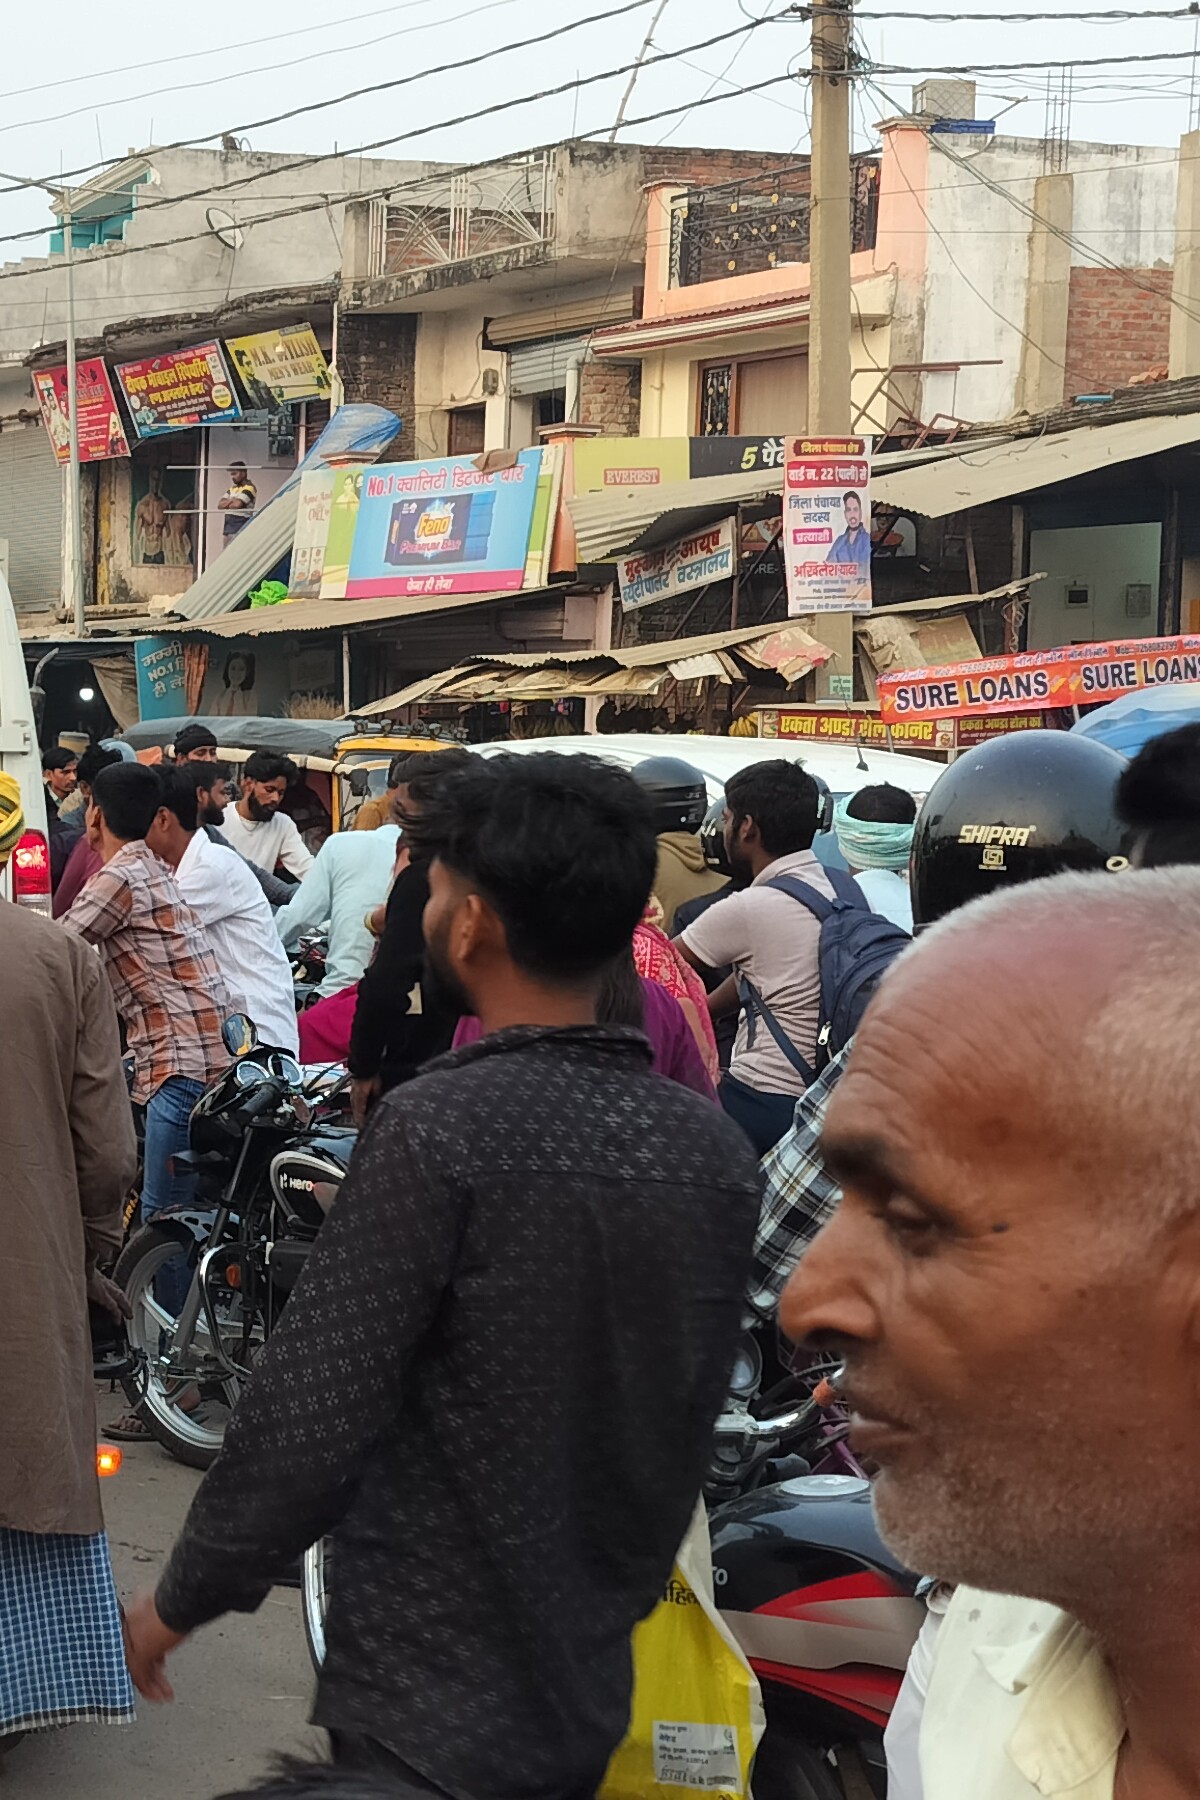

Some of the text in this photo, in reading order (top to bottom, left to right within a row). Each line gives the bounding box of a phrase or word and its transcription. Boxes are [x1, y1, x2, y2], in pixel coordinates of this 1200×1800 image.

[740, 446, 758, 470] 5
[397, 467, 447, 493] क्वालिटी
[606, 470, 658, 484] EVEREST
[820, 467, 834, 481] 22
[789, 494, 842, 510] जिला पंचायत
[802, 511, 831, 524] सदस्य
[677, 549, 731, 584] वस्त्रालय
[793, 560, 838, 578] अखिलेश
[141, 639, 182, 667] मम्मी
[1083, 662, 1137, 691] SURE
[896, 672, 1049, 711] SURE LOANS
[781, 715, 818, 734] एकता
[1029, 716, 1042, 728] का
[958, 824, 1031, 847] SHIPRA
[289, 1177, 313, 1192] Hero
